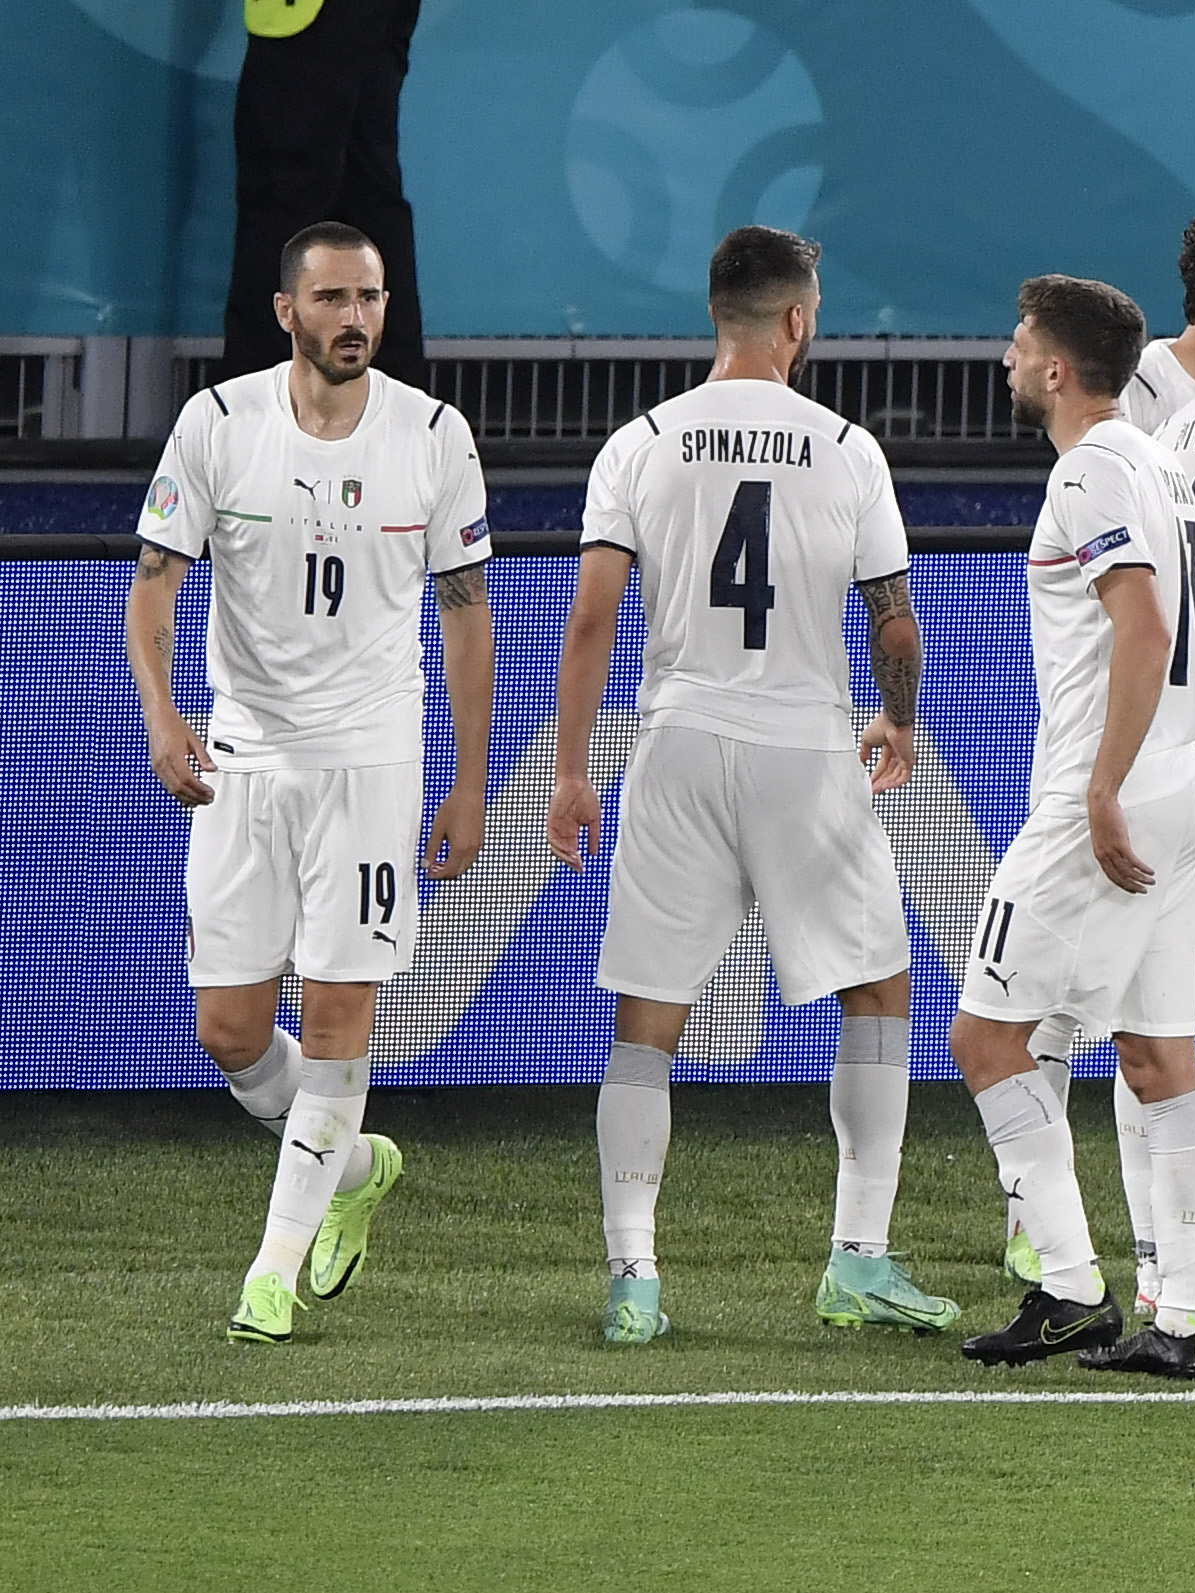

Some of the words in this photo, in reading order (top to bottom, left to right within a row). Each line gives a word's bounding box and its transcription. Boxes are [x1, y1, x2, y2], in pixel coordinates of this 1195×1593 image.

[682, 428, 812, 469] SPINAZZOLA
[290, 518, 362, 532] ITALIA
[1090, 529, 1128, 557] RESPECT
[304, 553, 346, 617] 19
[709, 480, 775, 650] 4
[358, 863, 396, 925] 19
[978, 897, 1016, 965] 11
[615, 1170, 659, 1185] ITALIA
